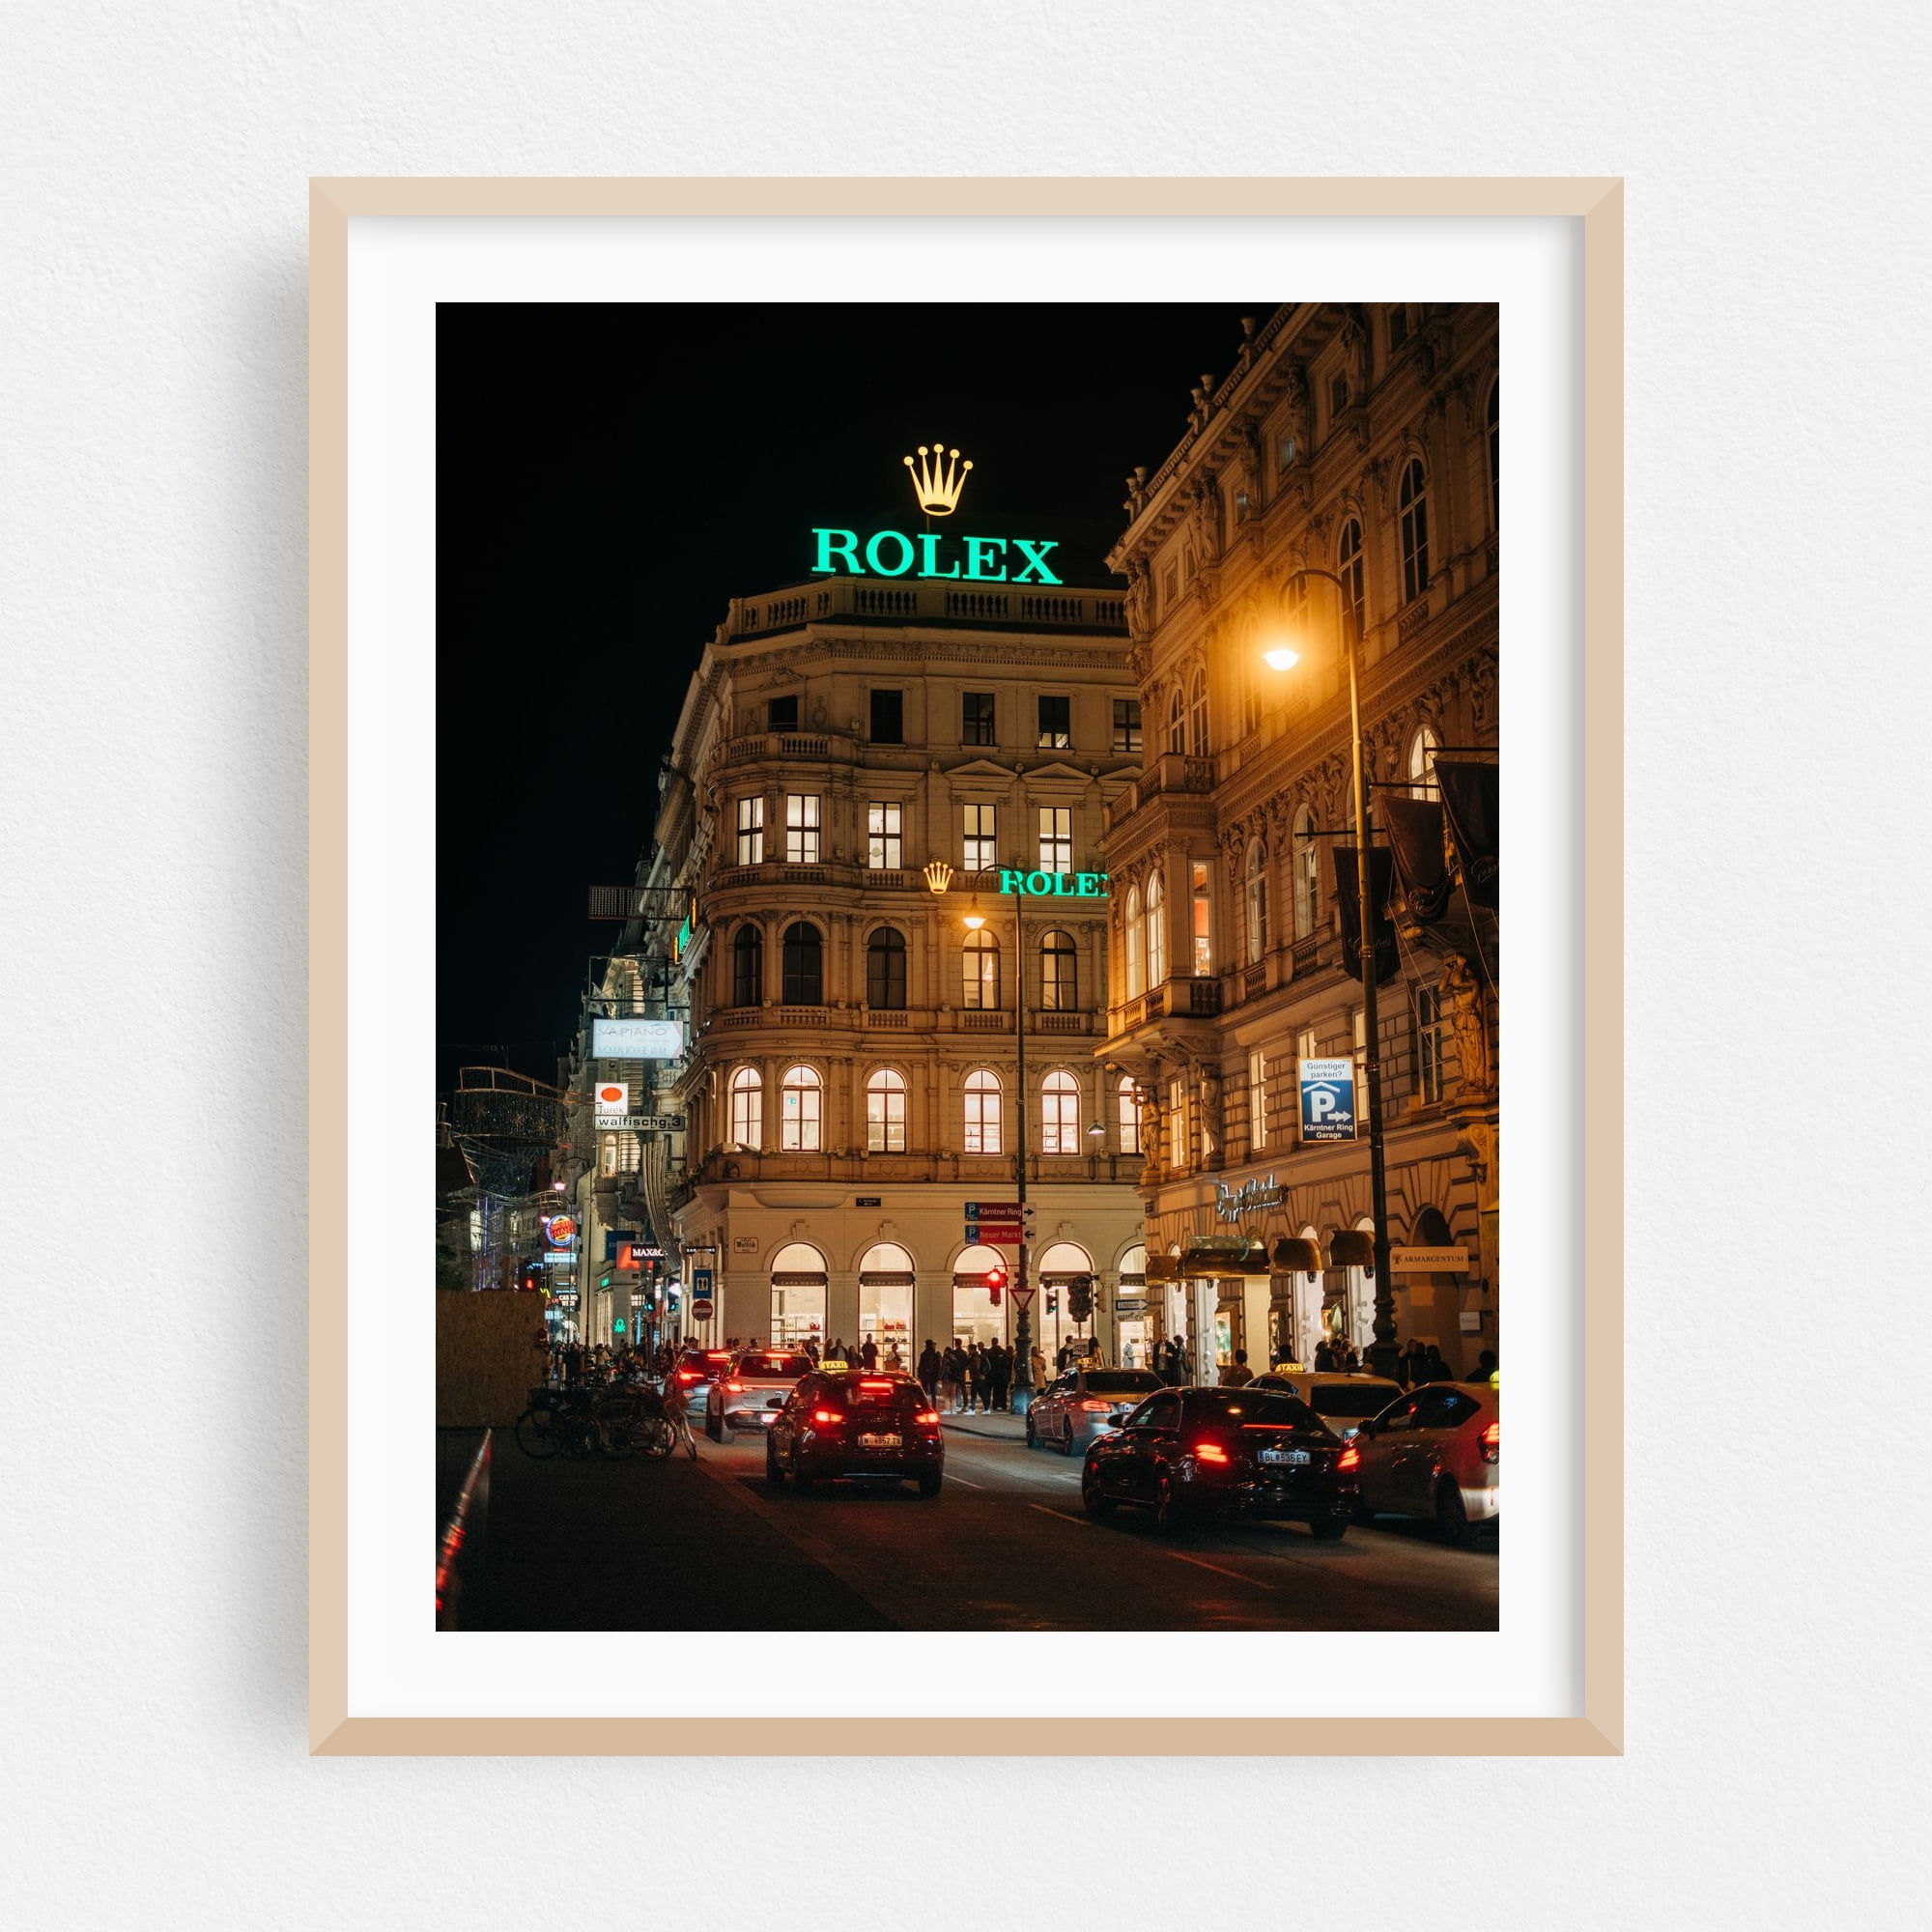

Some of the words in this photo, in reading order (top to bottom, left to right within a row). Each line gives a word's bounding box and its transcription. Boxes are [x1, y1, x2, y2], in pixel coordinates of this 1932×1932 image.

[811, 527, 1063, 584] ROLEX
[599, 1027, 667, 1037] VAPIANO
[598, 1105, 624, 1114] Turek
[1311, 1091, 1336, 1122] P
[599, 1117, 681, 1128] walfischg.3
[1336, 1123, 1353, 1132] Ring
[1007, 1208, 1022, 1216] Ring
